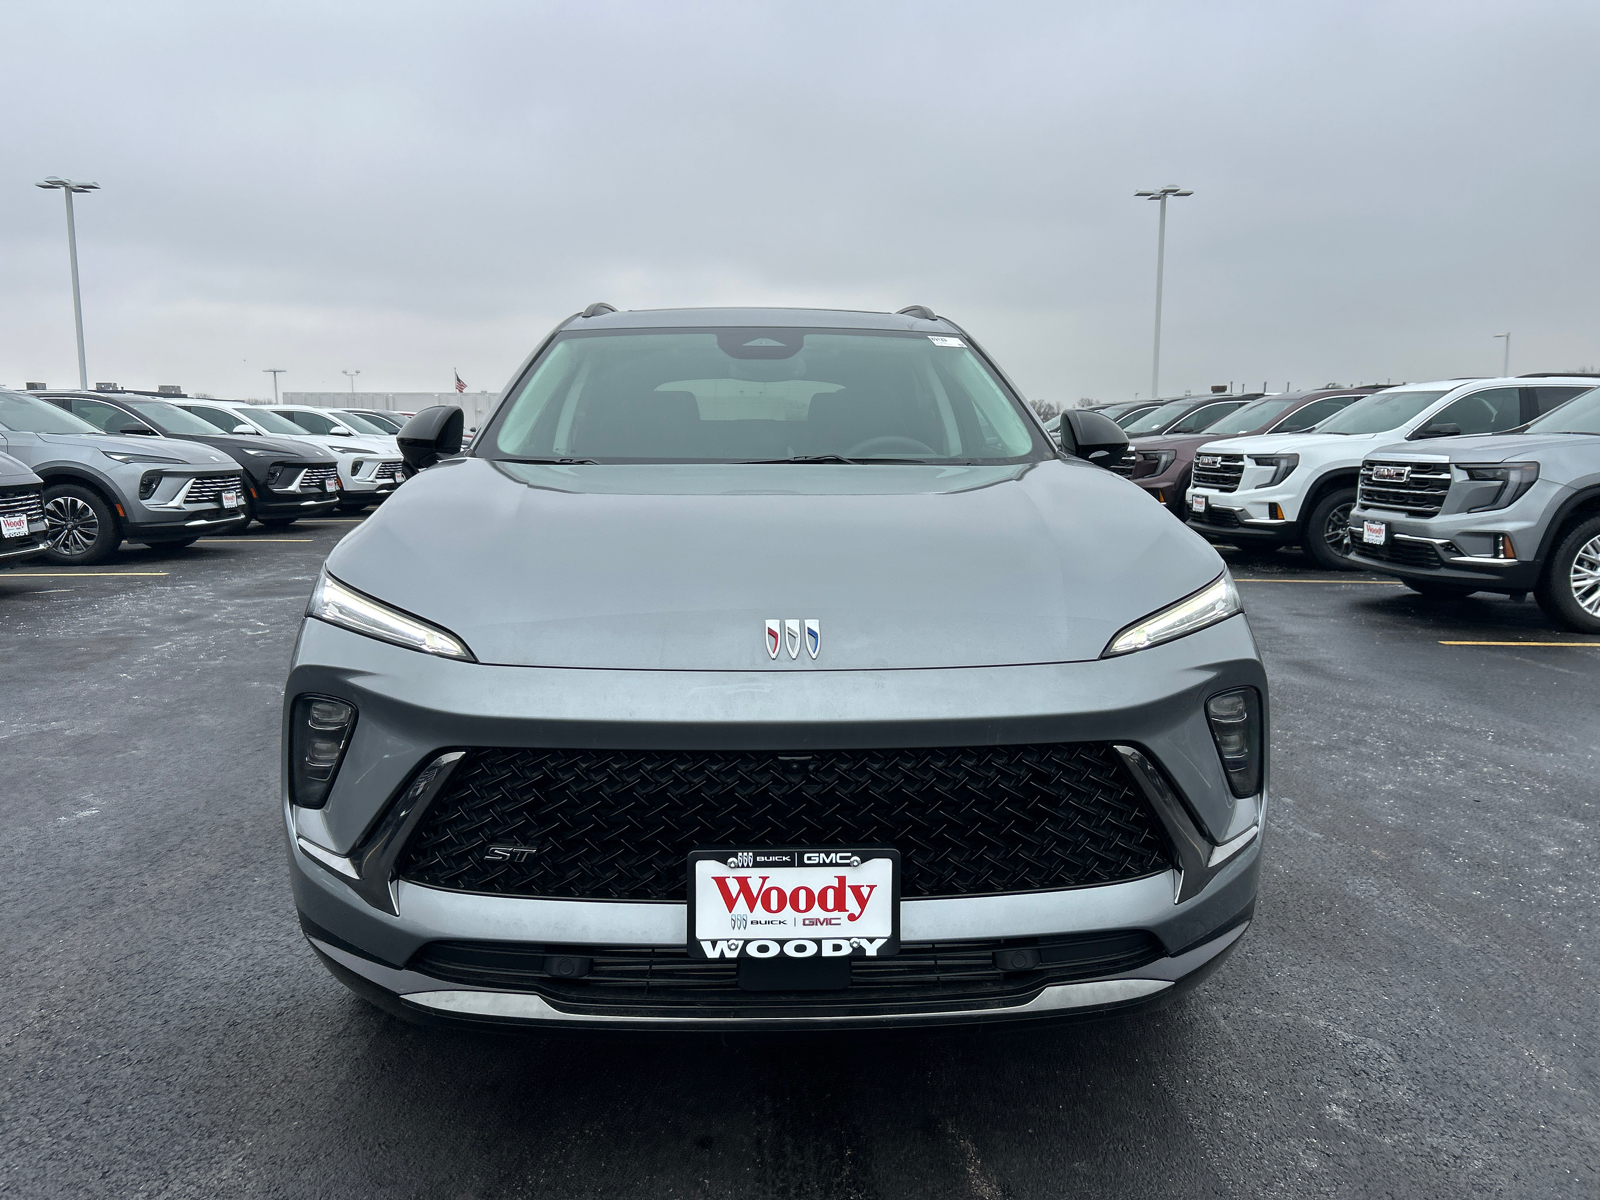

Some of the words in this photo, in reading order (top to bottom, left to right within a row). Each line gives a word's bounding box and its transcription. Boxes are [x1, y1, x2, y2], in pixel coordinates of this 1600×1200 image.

[3, 518, 25, 529] Woody
[484, 845, 537, 862] ST
[803, 853, 852, 864] GMC
[711, 875, 878, 922] Woody
[802, 917, 842, 926] GMC
[700, 938, 888, 959] WOODY
